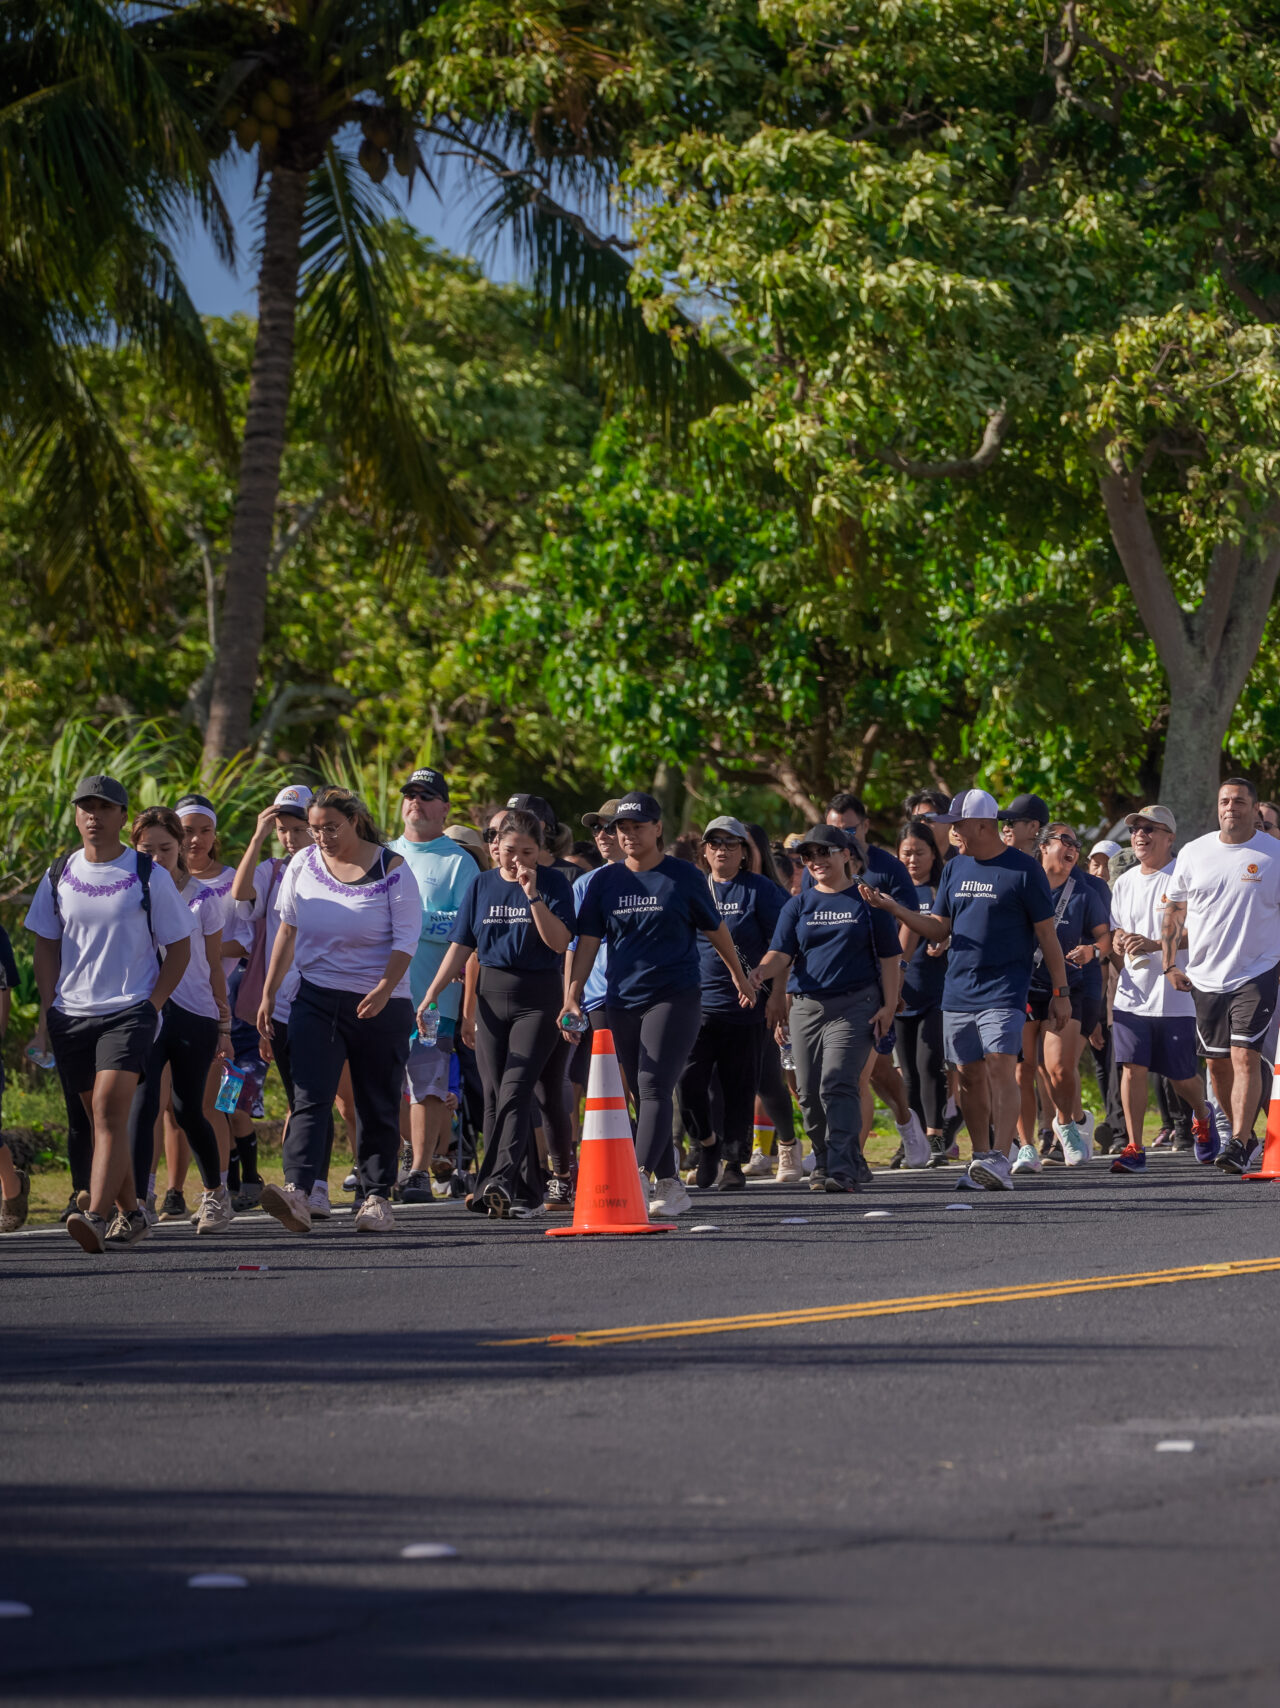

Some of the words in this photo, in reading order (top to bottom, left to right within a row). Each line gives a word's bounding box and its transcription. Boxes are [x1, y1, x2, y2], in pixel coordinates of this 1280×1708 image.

[617, 802, 642, 814] HOKA
[960, 880, 993, 892] Hilton
[618, 894, 658, 908] Hilton
[489, 905, 527, 917] Hilton
[612, 908, 632, 916] GRAND
[813, 911, 852, 921] Hilton
